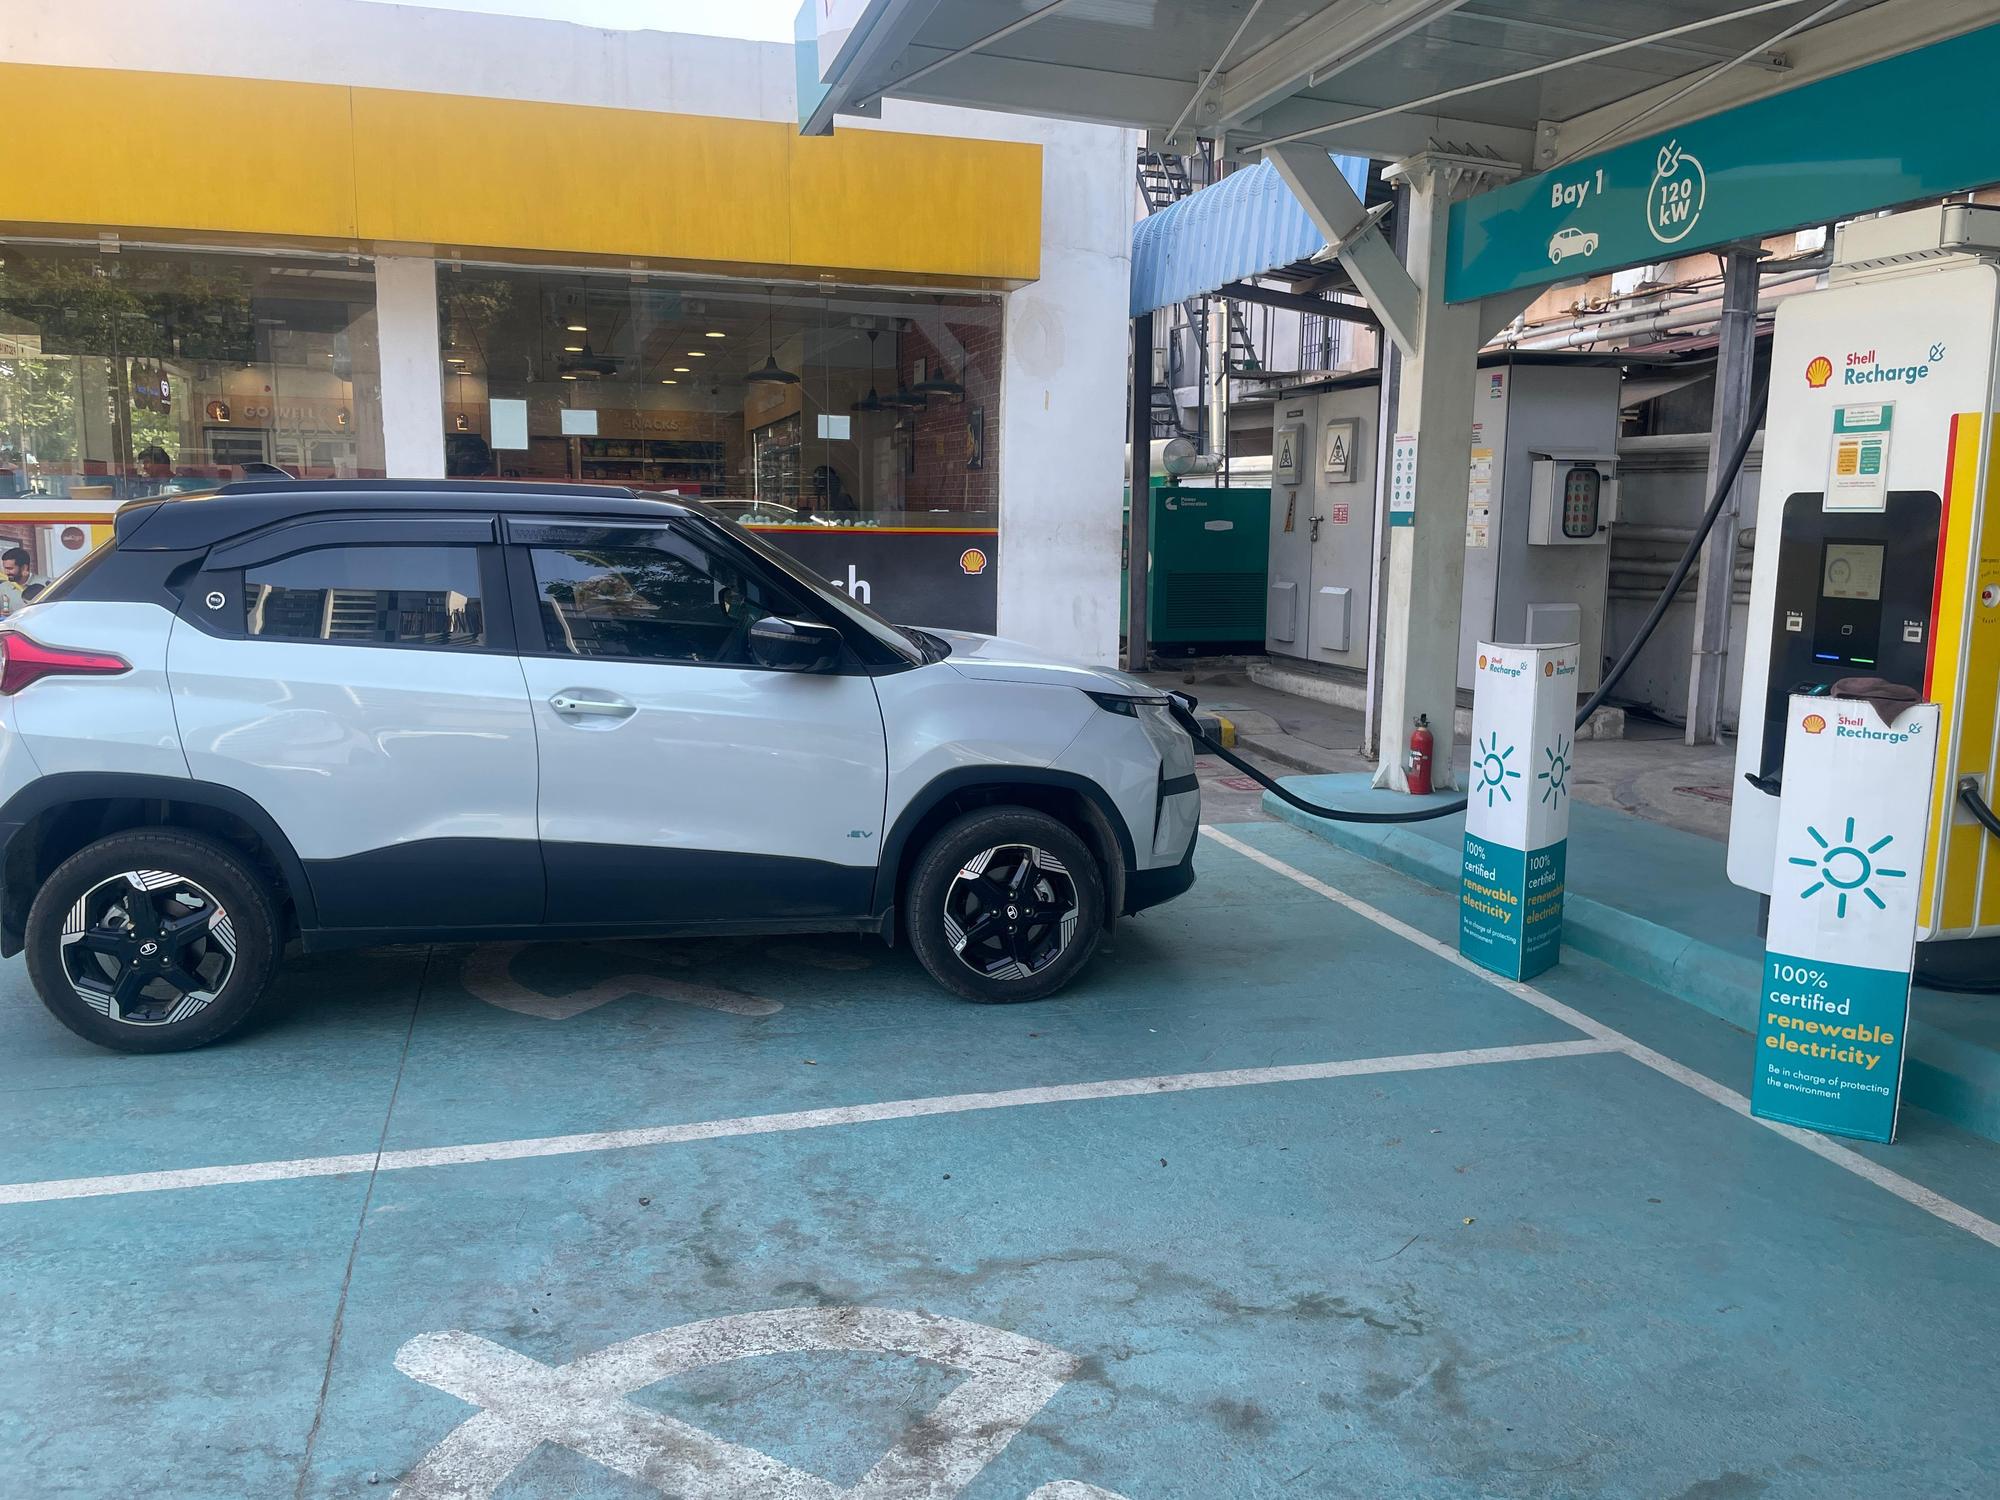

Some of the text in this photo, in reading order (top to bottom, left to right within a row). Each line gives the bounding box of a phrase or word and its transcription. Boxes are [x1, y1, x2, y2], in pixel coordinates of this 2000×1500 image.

[1551, 169, 1603, 208] Bay 1
[1661, 178, 1692, 205] 120
[1659, 199, 1690, 227] kW
[1846, 350, 1875, 366] Shell
[1844, 363, 1929, 385] Recharge
[244, 406, 269, 418] GO
[624, 418, 679, 432] SNACKS
[830, 564, 871, 605] h
[1490, 664, 1520, 677] Recharge
[1838, 716, 1864, 727] Shell
[1836, 725, 1909, 744] Recharge
[1466, 841, 1486, 859] 100%
[1465, 861, 1496, 880] certified
[1530, 854, 1551, 871] 100%
[1528, 867, 1556, 889] certified
[1463, 878, 1518, 906] renewable
[1462, 893, 1512, 924] electricity
[1772, 963, 1828, 989] 100%
[1769, 990, 1850, 1016] certified
[1767, 1012, 1895, 1045] renewable
[1765, 1033, 1881, 1070] electricity
[1767, 1077, 1841, 1100] the environment
[1768, 1063, 1890, 1096] Be in charge of protecting
